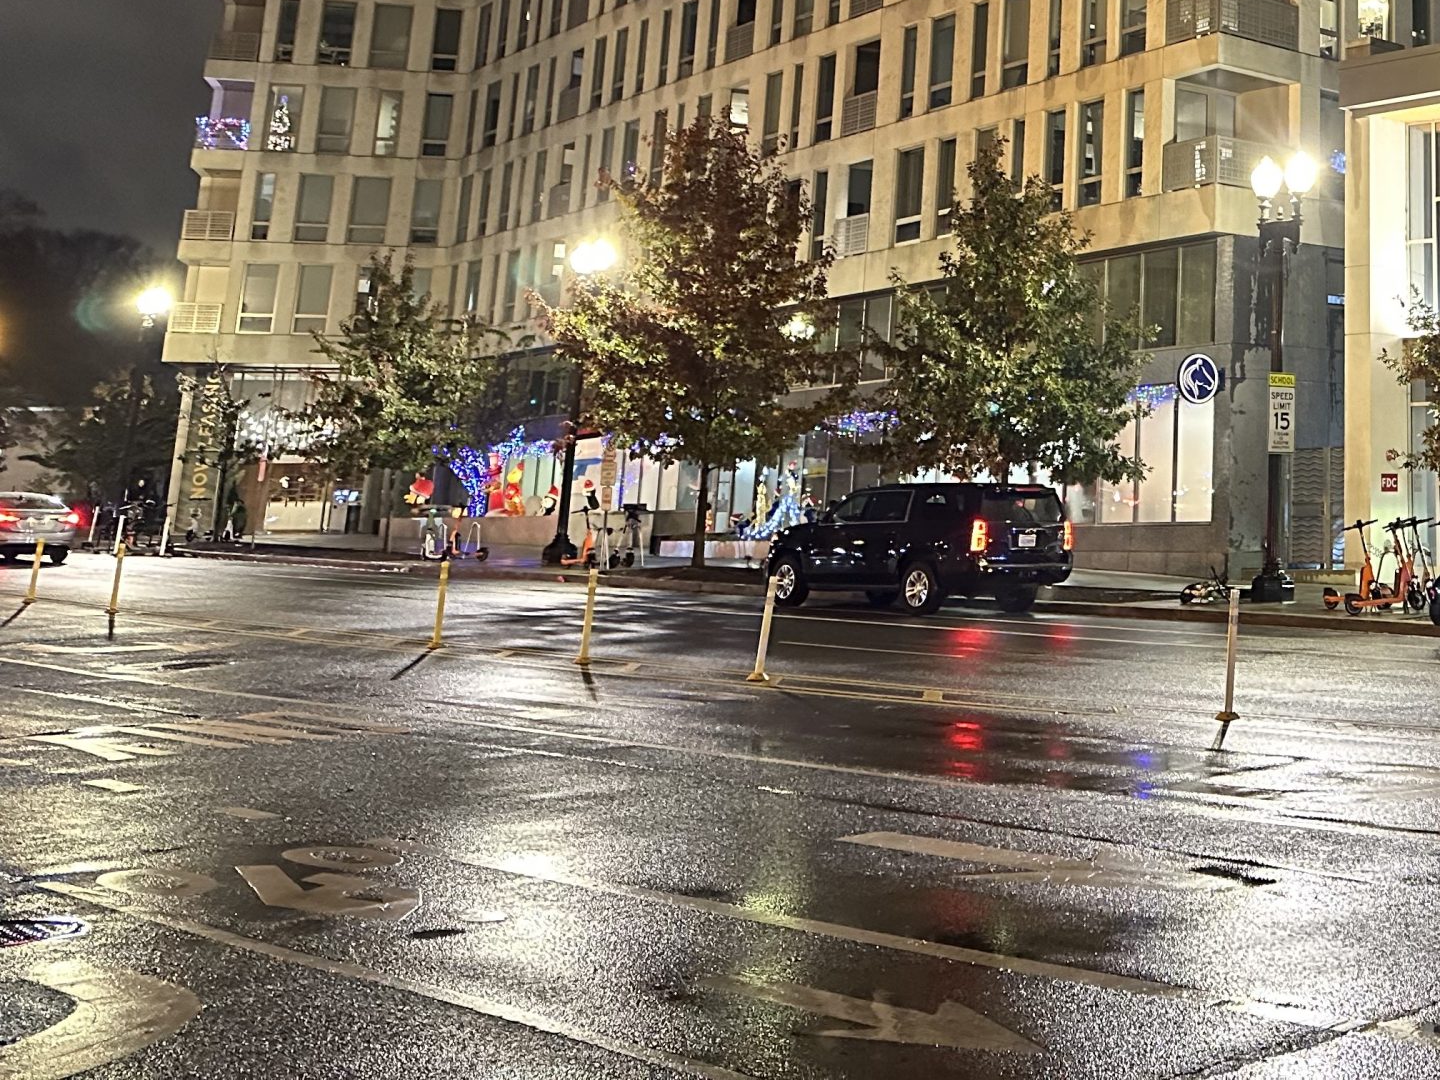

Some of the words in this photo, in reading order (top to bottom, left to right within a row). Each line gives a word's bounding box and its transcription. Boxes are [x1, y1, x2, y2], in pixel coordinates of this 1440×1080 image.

[1270, 376, 1294, 385] SCHOOL
[1271, 392, 1293, 401] SPEED
[1273, 402, 1291, 410] LIMIT
[1274, 412, 1290, 430] 15
[1382, 477, 1397, 488] FDC
